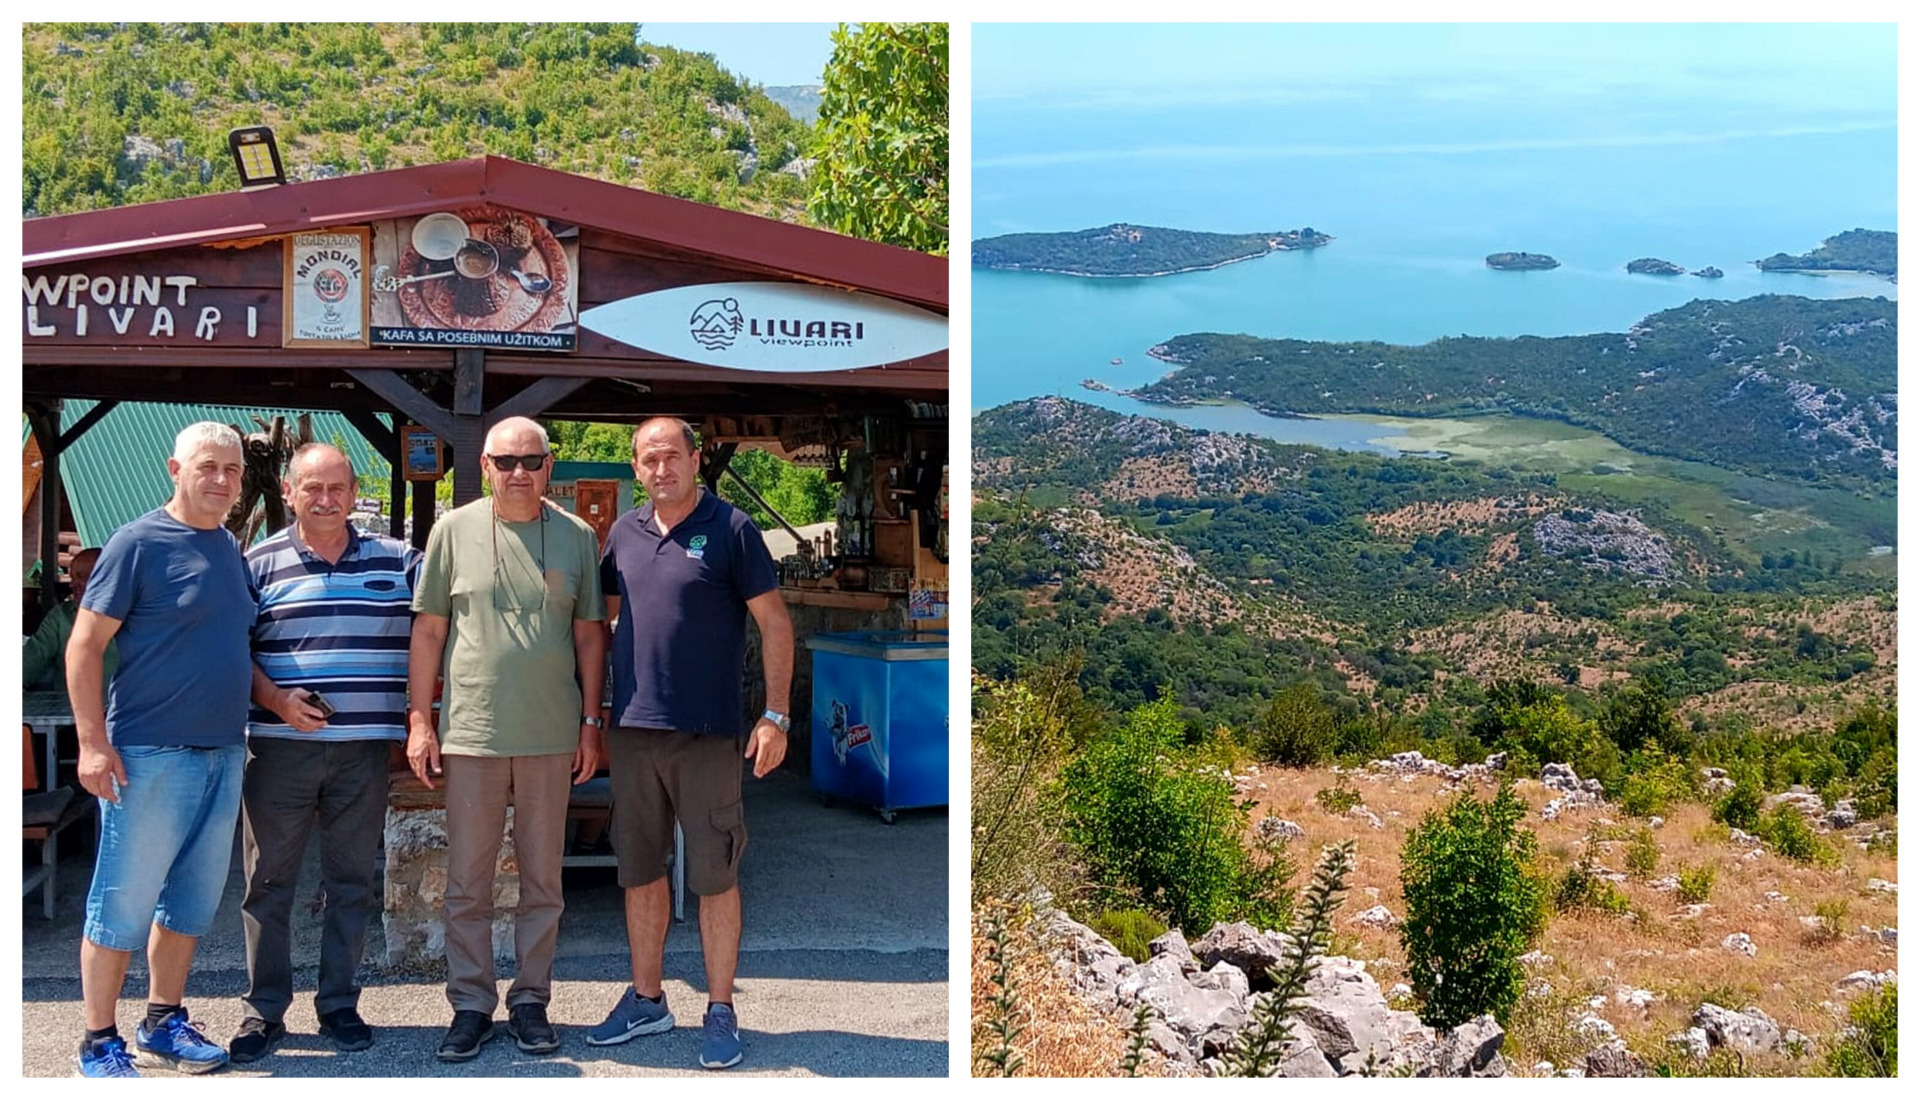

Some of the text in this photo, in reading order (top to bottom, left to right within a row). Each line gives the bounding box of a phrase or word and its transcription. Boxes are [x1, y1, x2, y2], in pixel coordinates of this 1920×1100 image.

[297, 250, 362, 279] MONDIAL
[22, 274, 197, 309] WPOINT
[27, 304, 257, 341] LIVARI
[750, 319, 863, 339] LIVARI
[383, 330, 562, 347] KAFA SA POSEBNIM UŽITKOM
[760, 338, 855, 347] viewpoint
